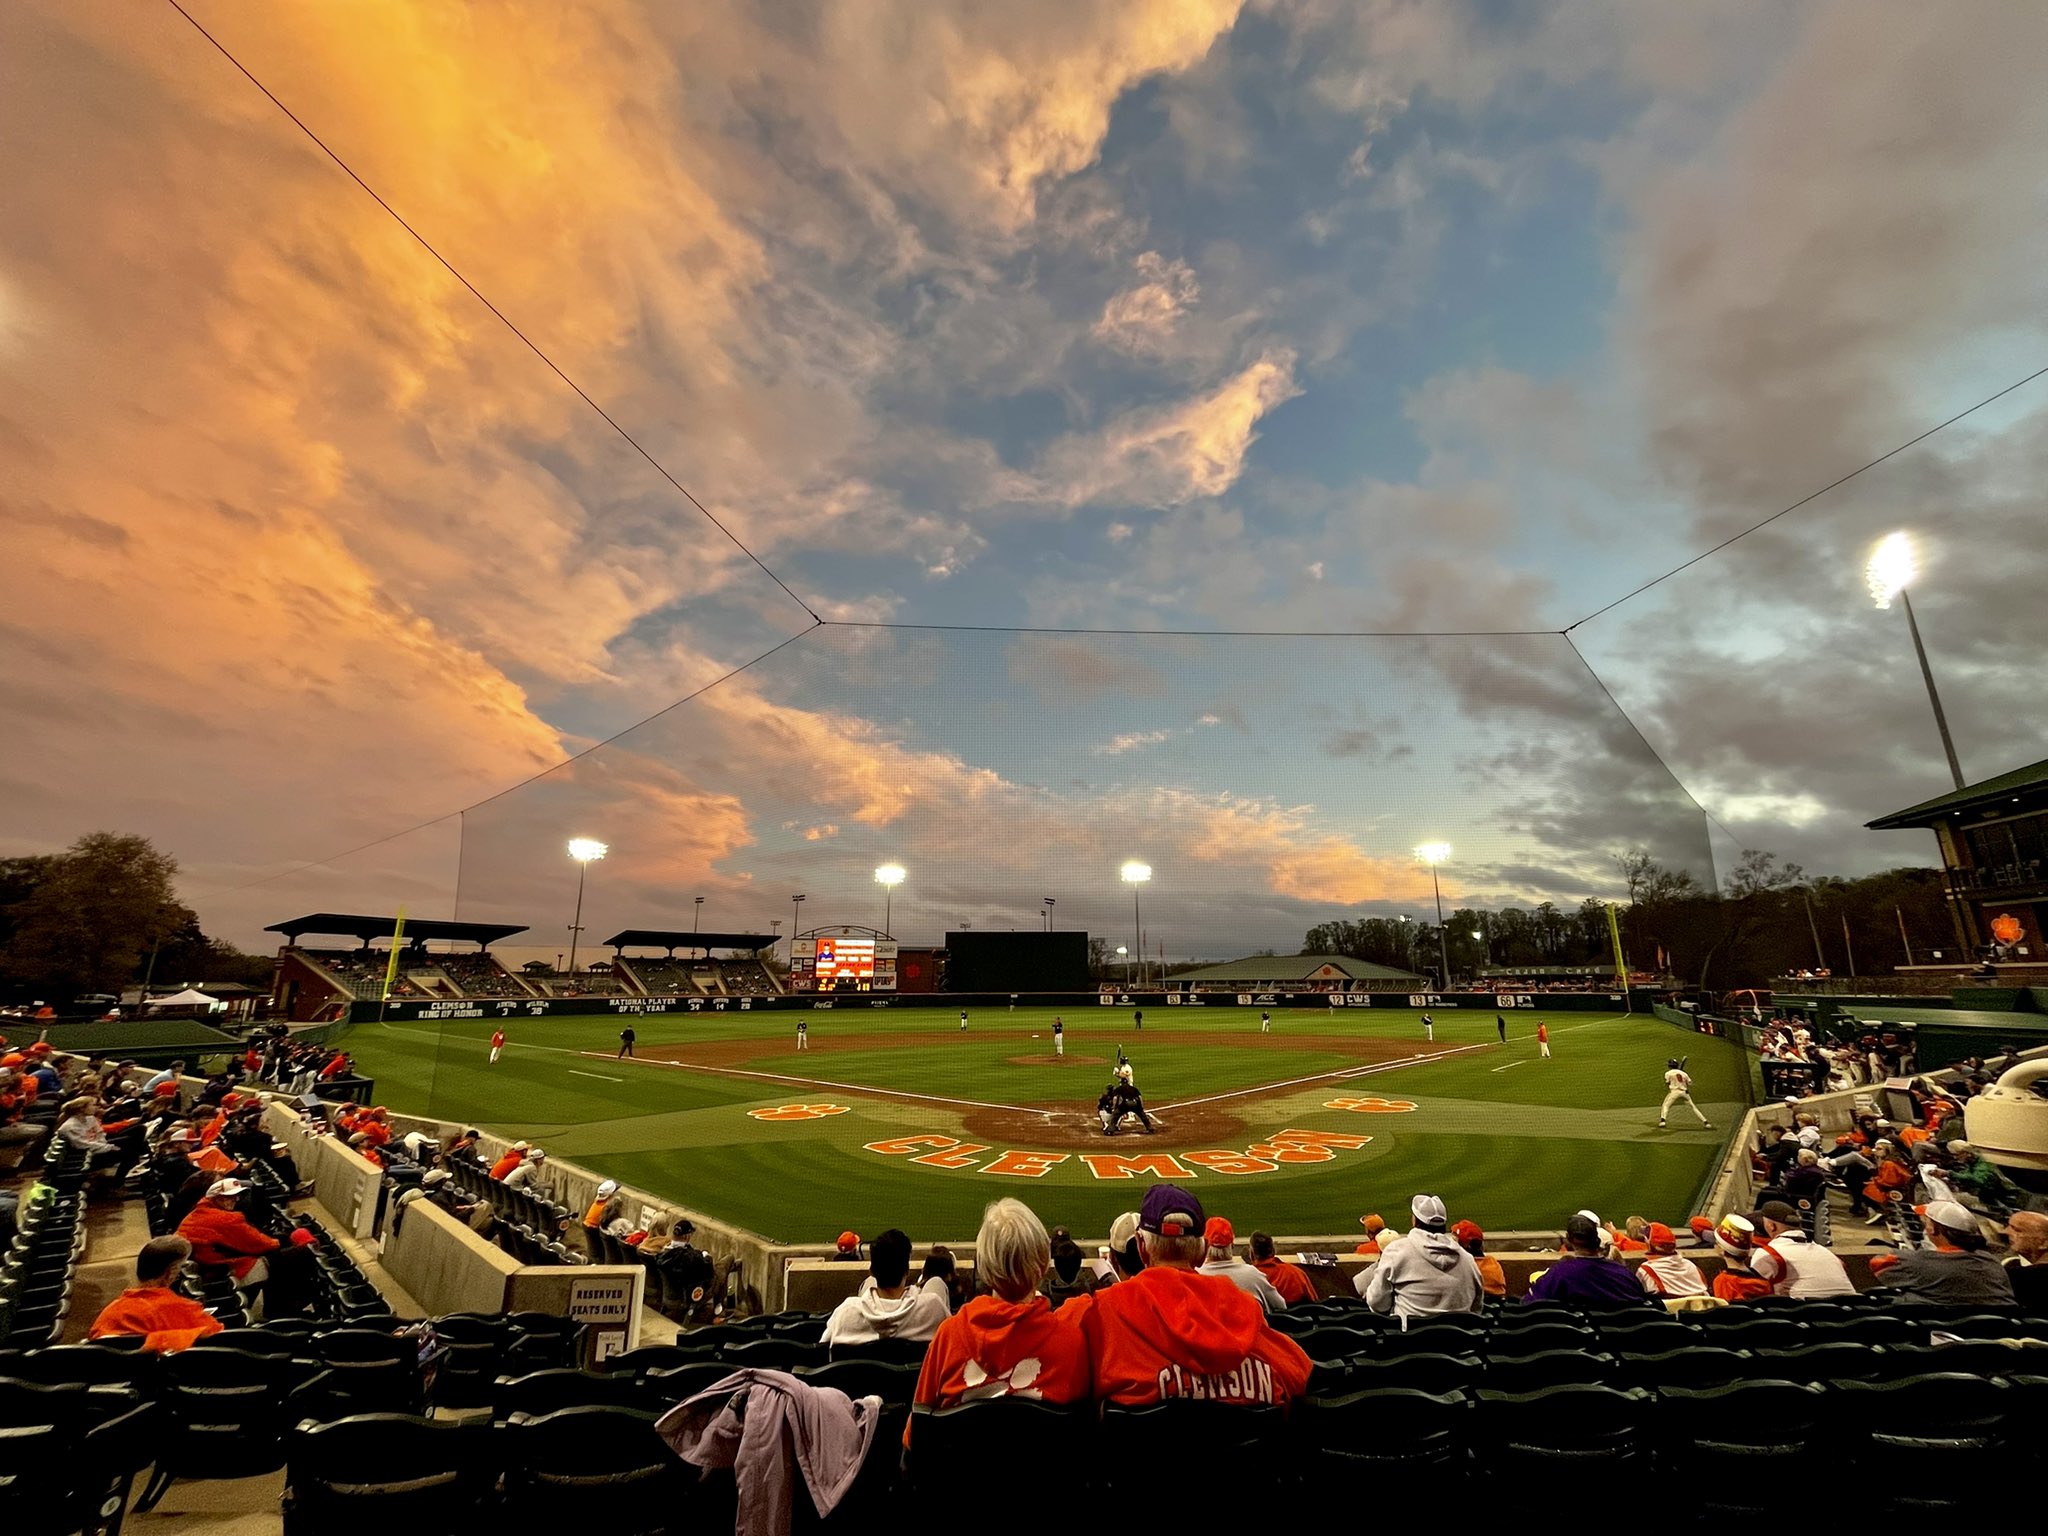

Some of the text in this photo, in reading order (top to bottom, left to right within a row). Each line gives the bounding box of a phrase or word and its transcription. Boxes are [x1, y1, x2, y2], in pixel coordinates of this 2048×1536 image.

[1346, 994, 1371, 1003] CWS
[501, 1007, 509, 1016] 3
[716, 1003, 726, 1011] 14
[418, 1009, 483, 1019] RING OF HONOR
[862, 1128, 1374, 1178] CLEMSN
[577, 1289, 623, 1299] RESERVED
[571, 1305, 627, 1315] SEATS ONLY
